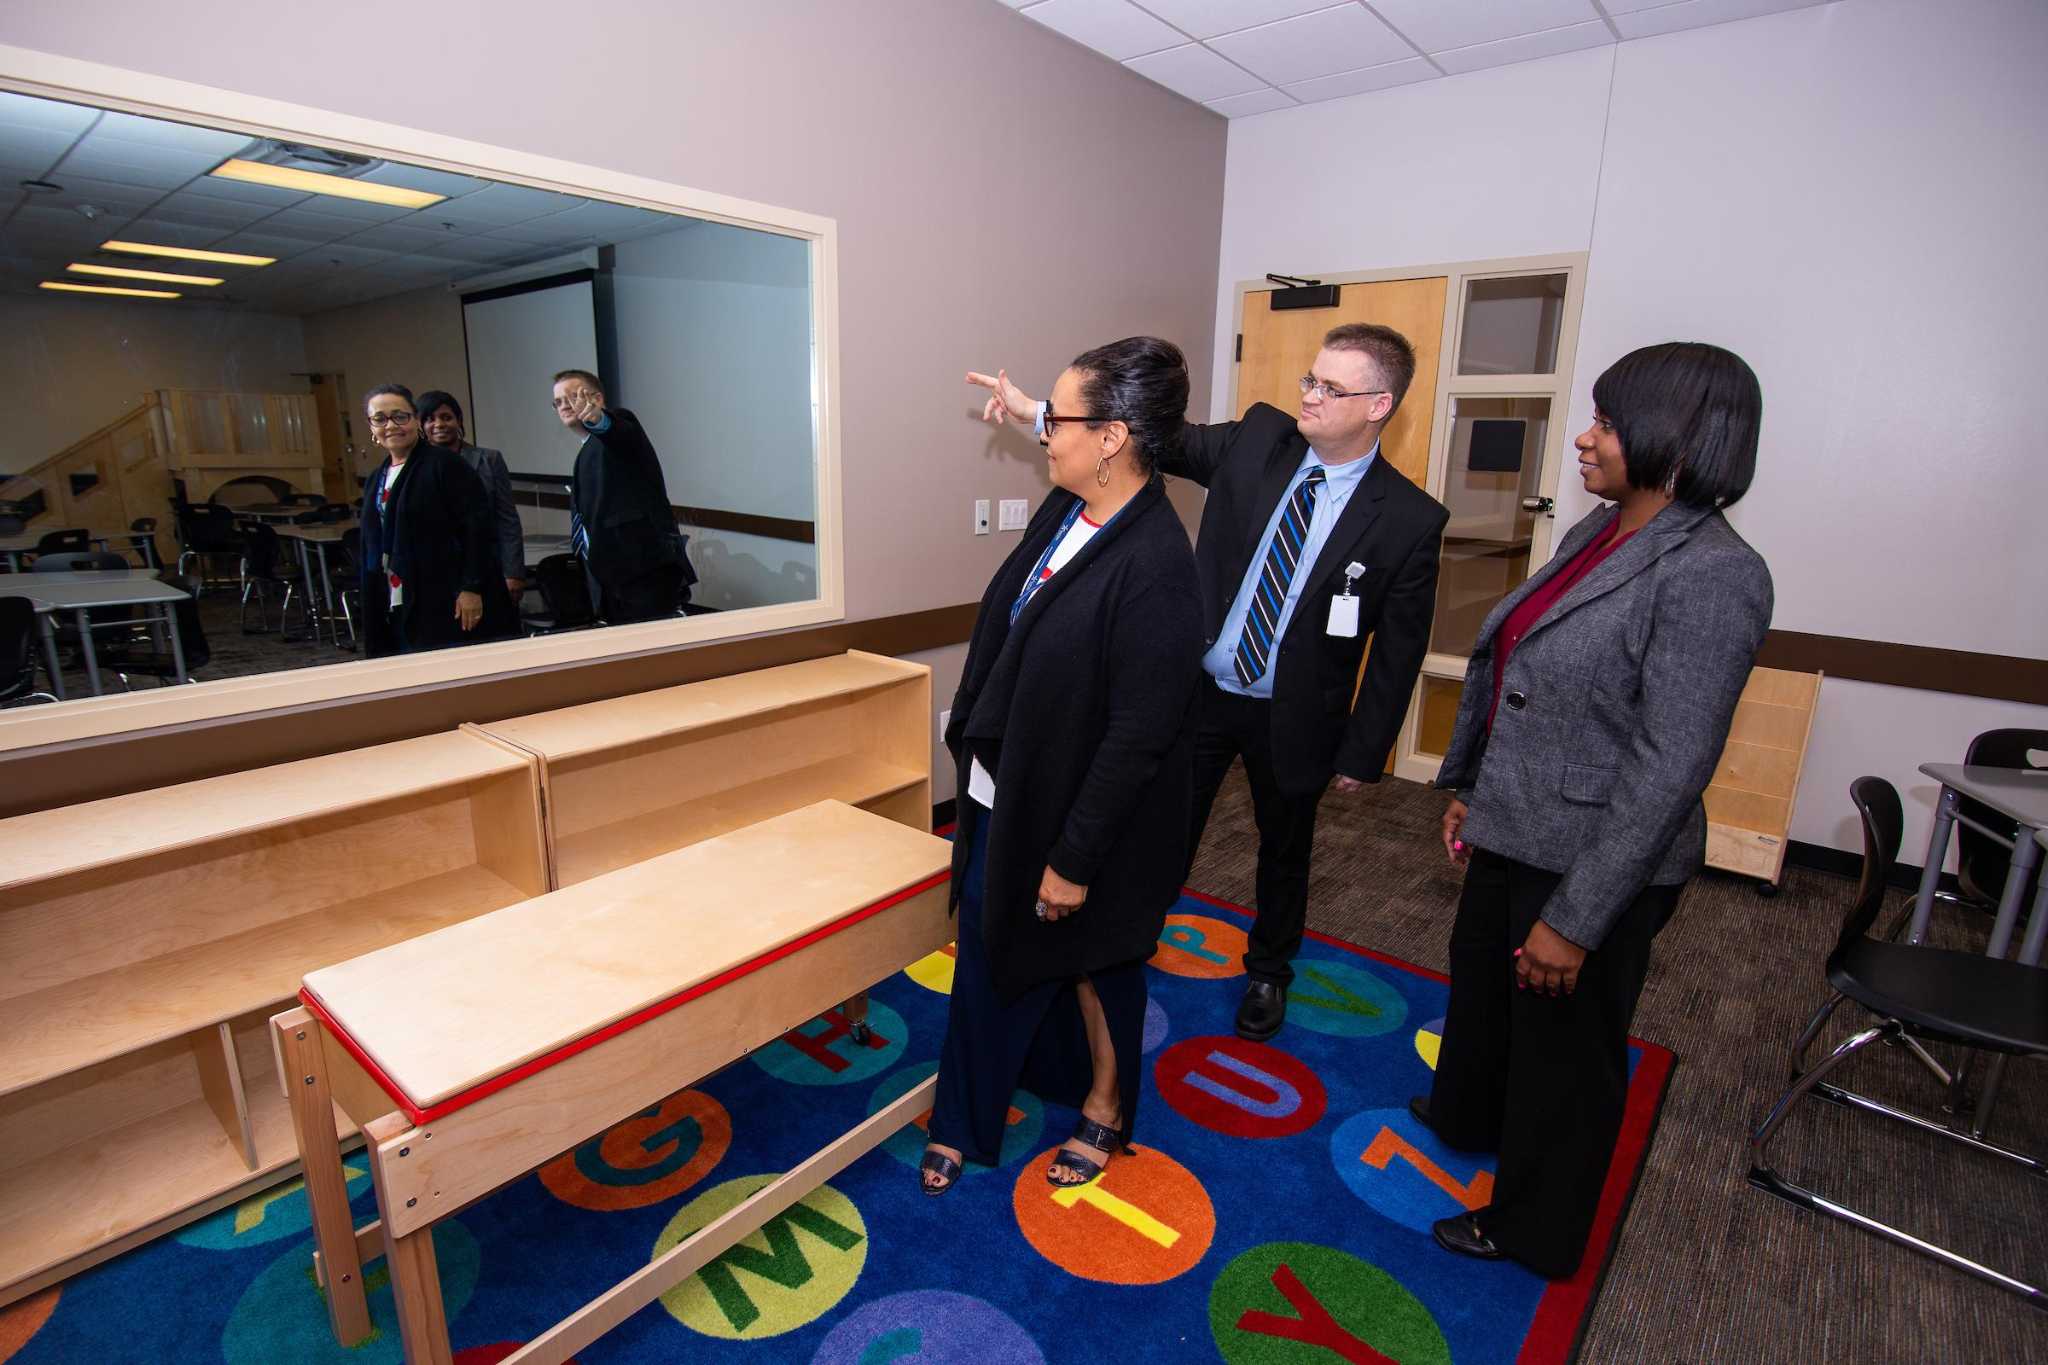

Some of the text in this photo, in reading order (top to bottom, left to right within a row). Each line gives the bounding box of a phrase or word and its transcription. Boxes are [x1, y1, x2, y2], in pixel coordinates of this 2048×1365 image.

[1287, 967, 1382, 1019] V
[1181, 1050, 1302, 1118] U
[1051, 1172, 1181, 1248] T
